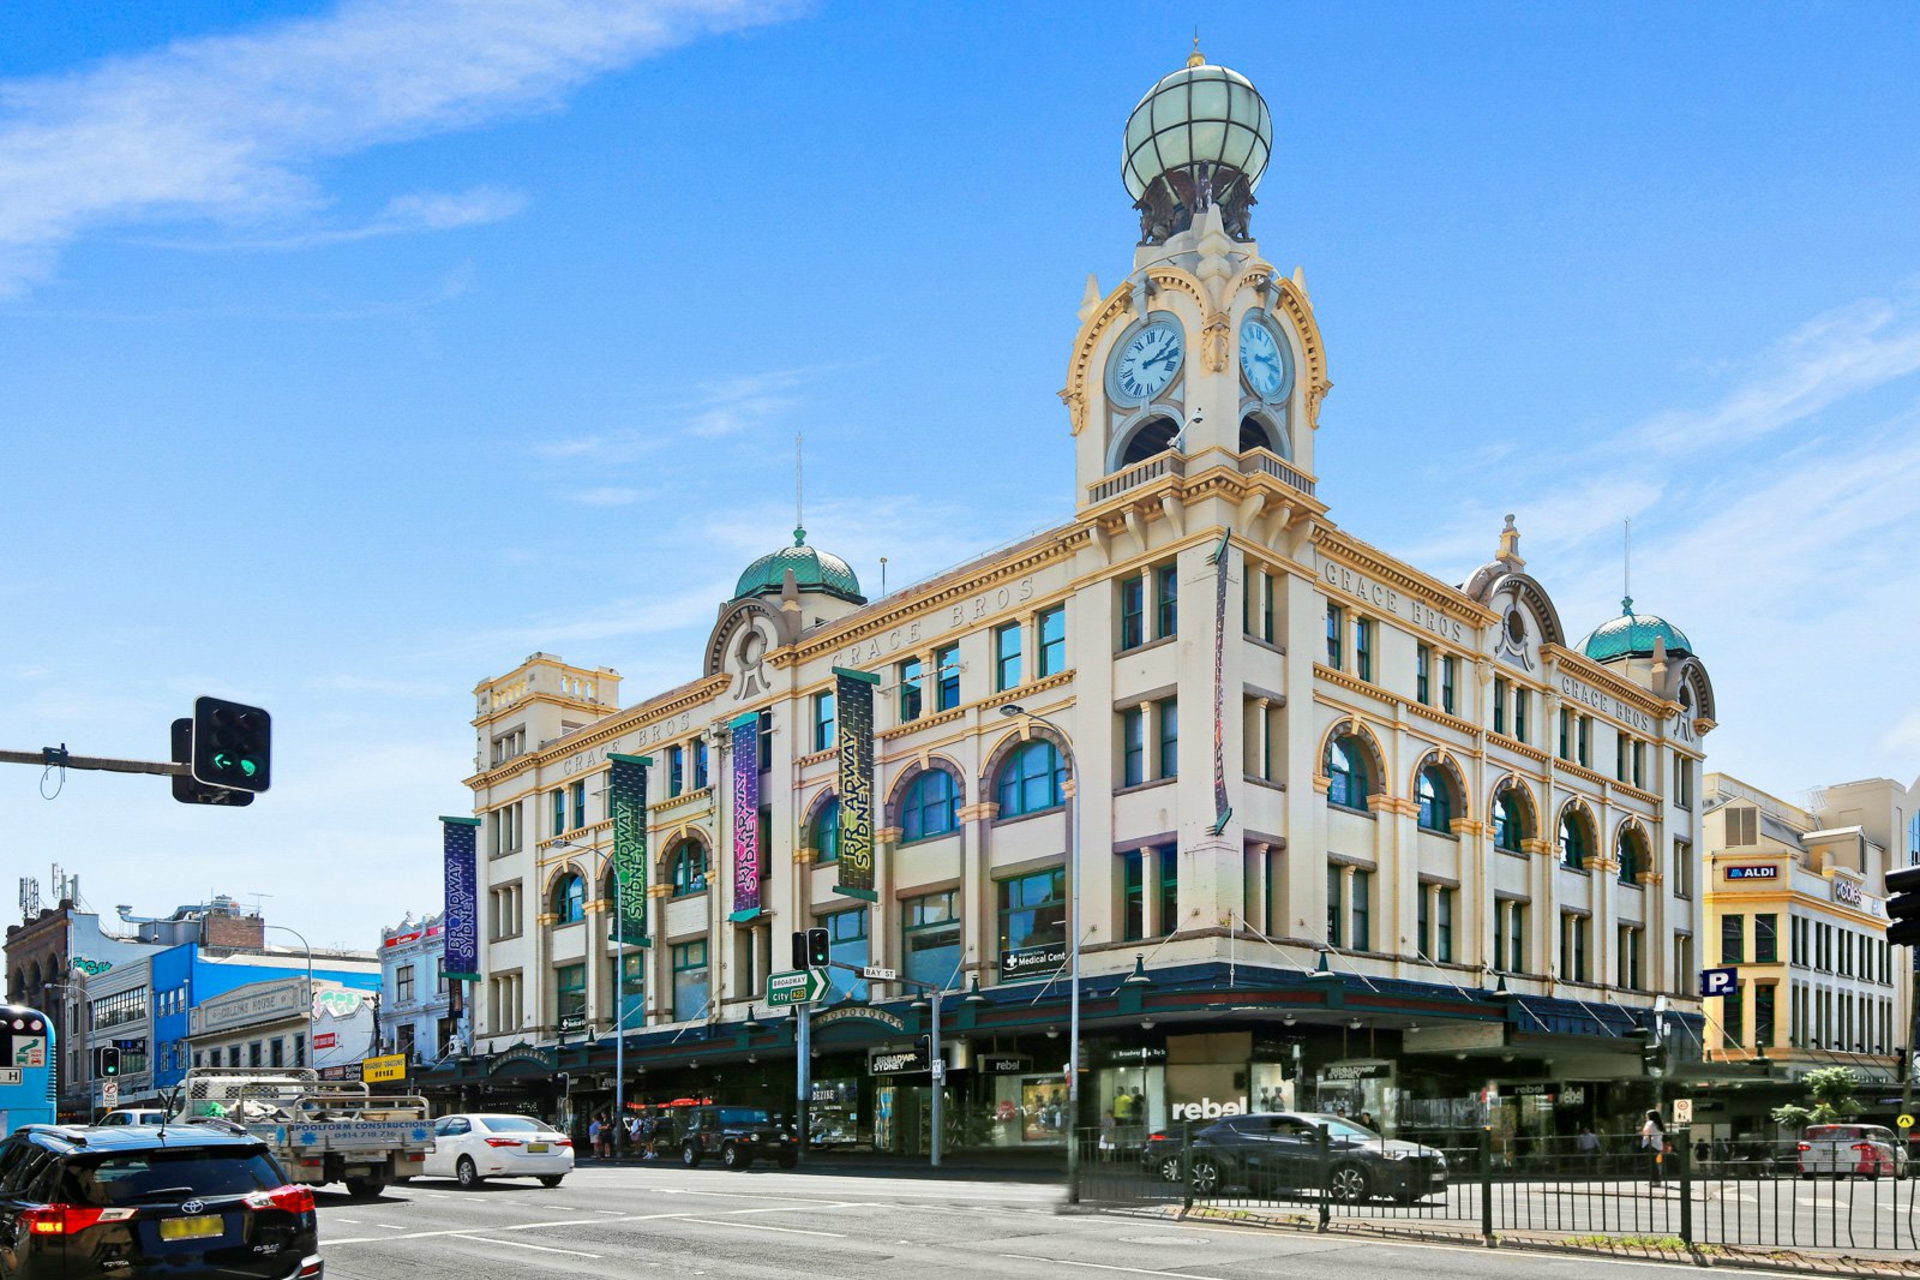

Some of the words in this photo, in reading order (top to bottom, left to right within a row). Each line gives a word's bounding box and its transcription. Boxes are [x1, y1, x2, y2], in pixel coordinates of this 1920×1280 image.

[1325, 561, 1398, 614] GRACE
[1411, 601, 1462, 643] BROS
[830, 621, 922, 669] GRACE
[951, 577, 1035, 629] BROS
[1561, 676, 1608, 713] GRACE
[1615, 701, 1649, 731] BROS
[638, 714, 690, 747] BROS
[855, 776, 870, 868] SYDNEY
[1744, 867, 1775, 878] ALDI
[629, 844, 643, 920] SYDNEY
[460, 891, 474, 958] SYDNEY
[1018, 954, 1047, 966] Medical
[866, 968, 882, 977] BAY
[885, 970, 894, 978] ST
[773, 976, 806, 988] BROADWAY
[1709, 972, 1729, 993] P
[772, 992, 789, 1002] City
[792, 990, 805, 998] A22
[221, 1000, 249, 1018] COLLINS
[252, 996, 276, 1013] HOUSE
[873, 1062, 905, 1072] SYDNEY
[996, 1059, 1020, 1071] rebel
[1328, 1071, 1361, 1079] SYDNEY
[1514, 1084, 1545, 1095] rebel
[1172, 1096, 1247, 1121] rebel
[355, 1121, 432, 1130] CONSTRUCTIONS
[103, 1260, 130, 1268] TOYOTA
